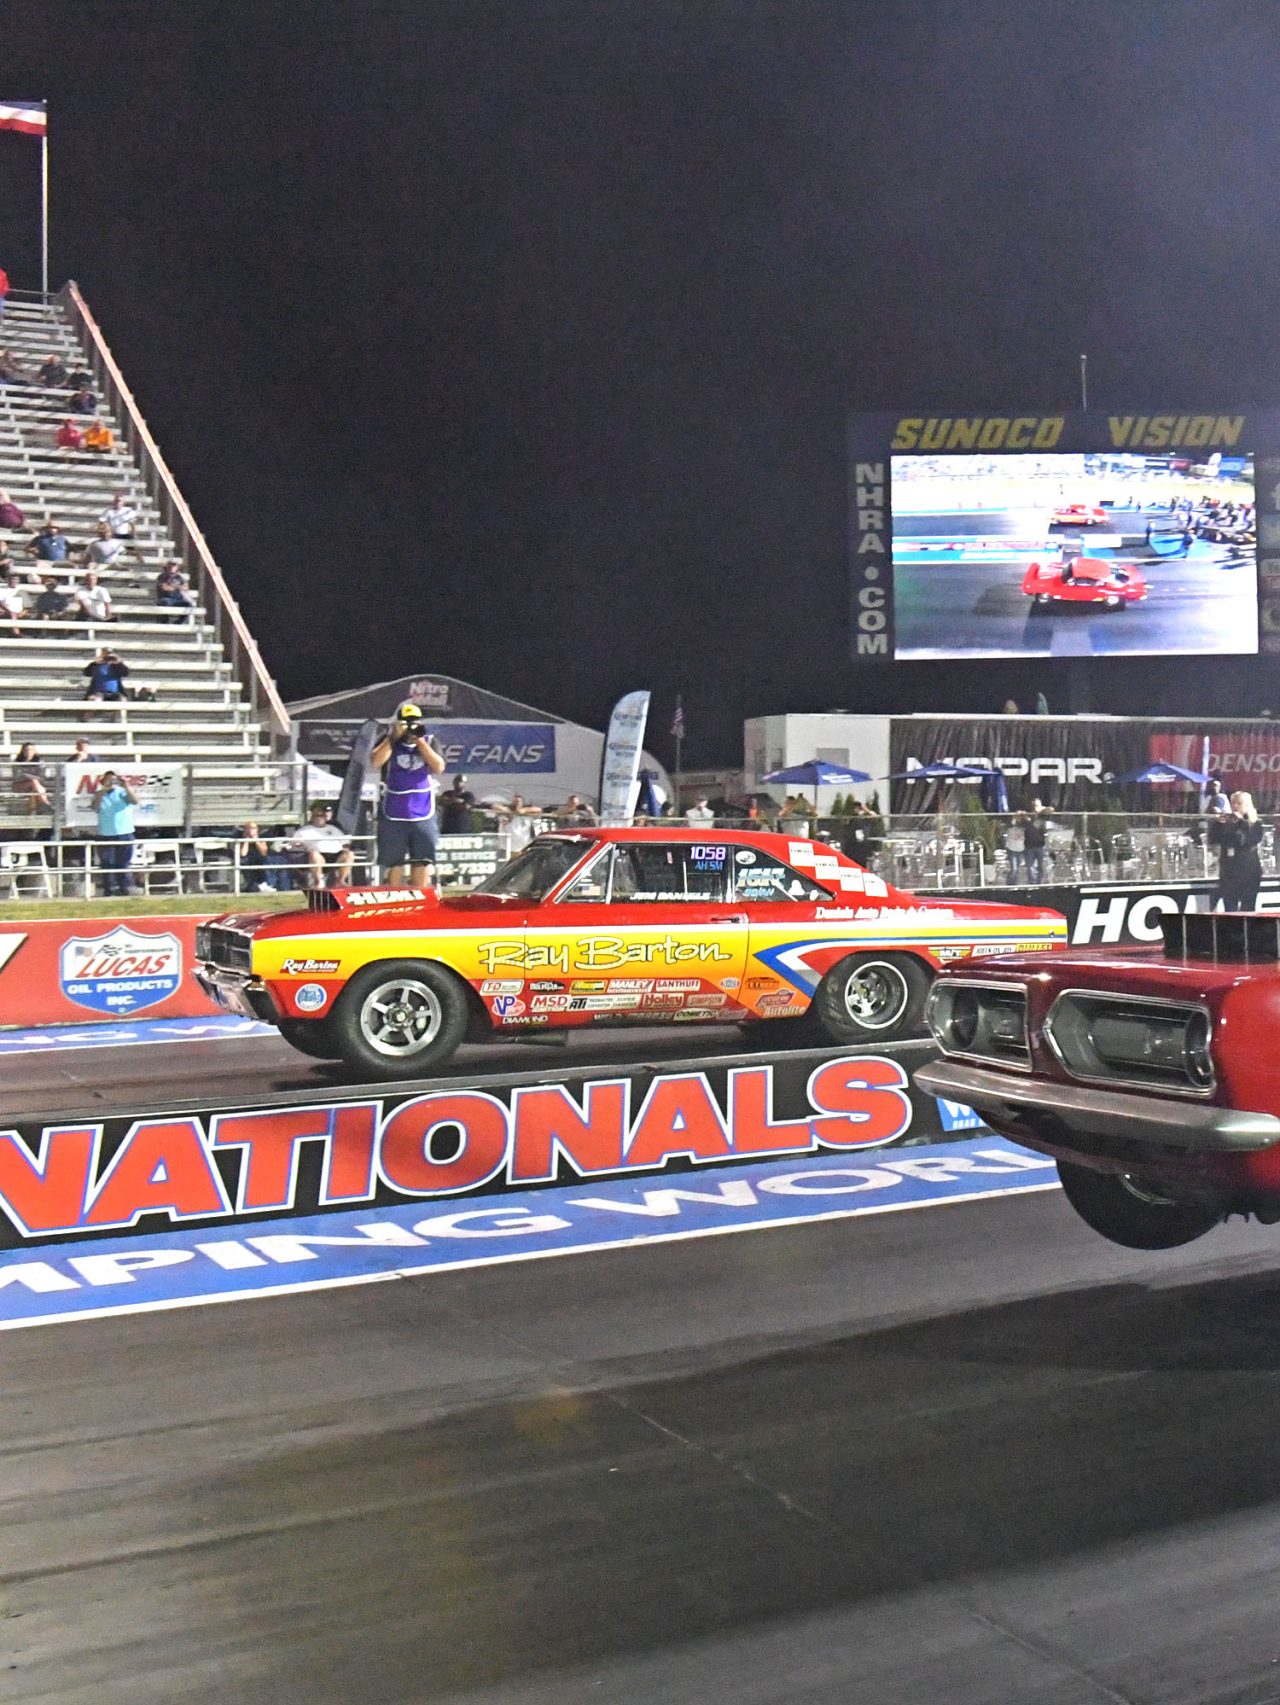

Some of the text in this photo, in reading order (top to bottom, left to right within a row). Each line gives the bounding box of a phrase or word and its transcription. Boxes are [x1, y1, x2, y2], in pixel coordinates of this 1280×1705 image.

[890, 415, 1247, 450] SUNOCO VISION
[466, 744, 545, 763] FANS
[906, 757, 1102, 784] MOPAR
[690, 846, 726, 860] 1058
[478, 935, 734, 975] Ray Barton
[75, 954, 172, 979] LUCAS
[66, 979, 173, 995] OIL PRODUCTS
[533, 995, 568, 1007] MSD
[568, 997, 588, 1010] ATI
[645, 994, 683, 1006] Holley
[502, 1015, 549, 1025] DIAMOND
[763, 1005, 807, 1018] Autolite
[0, 1055, 912, 1237] NATIONALS
[588, 1145, 1058, 1216] WORL
